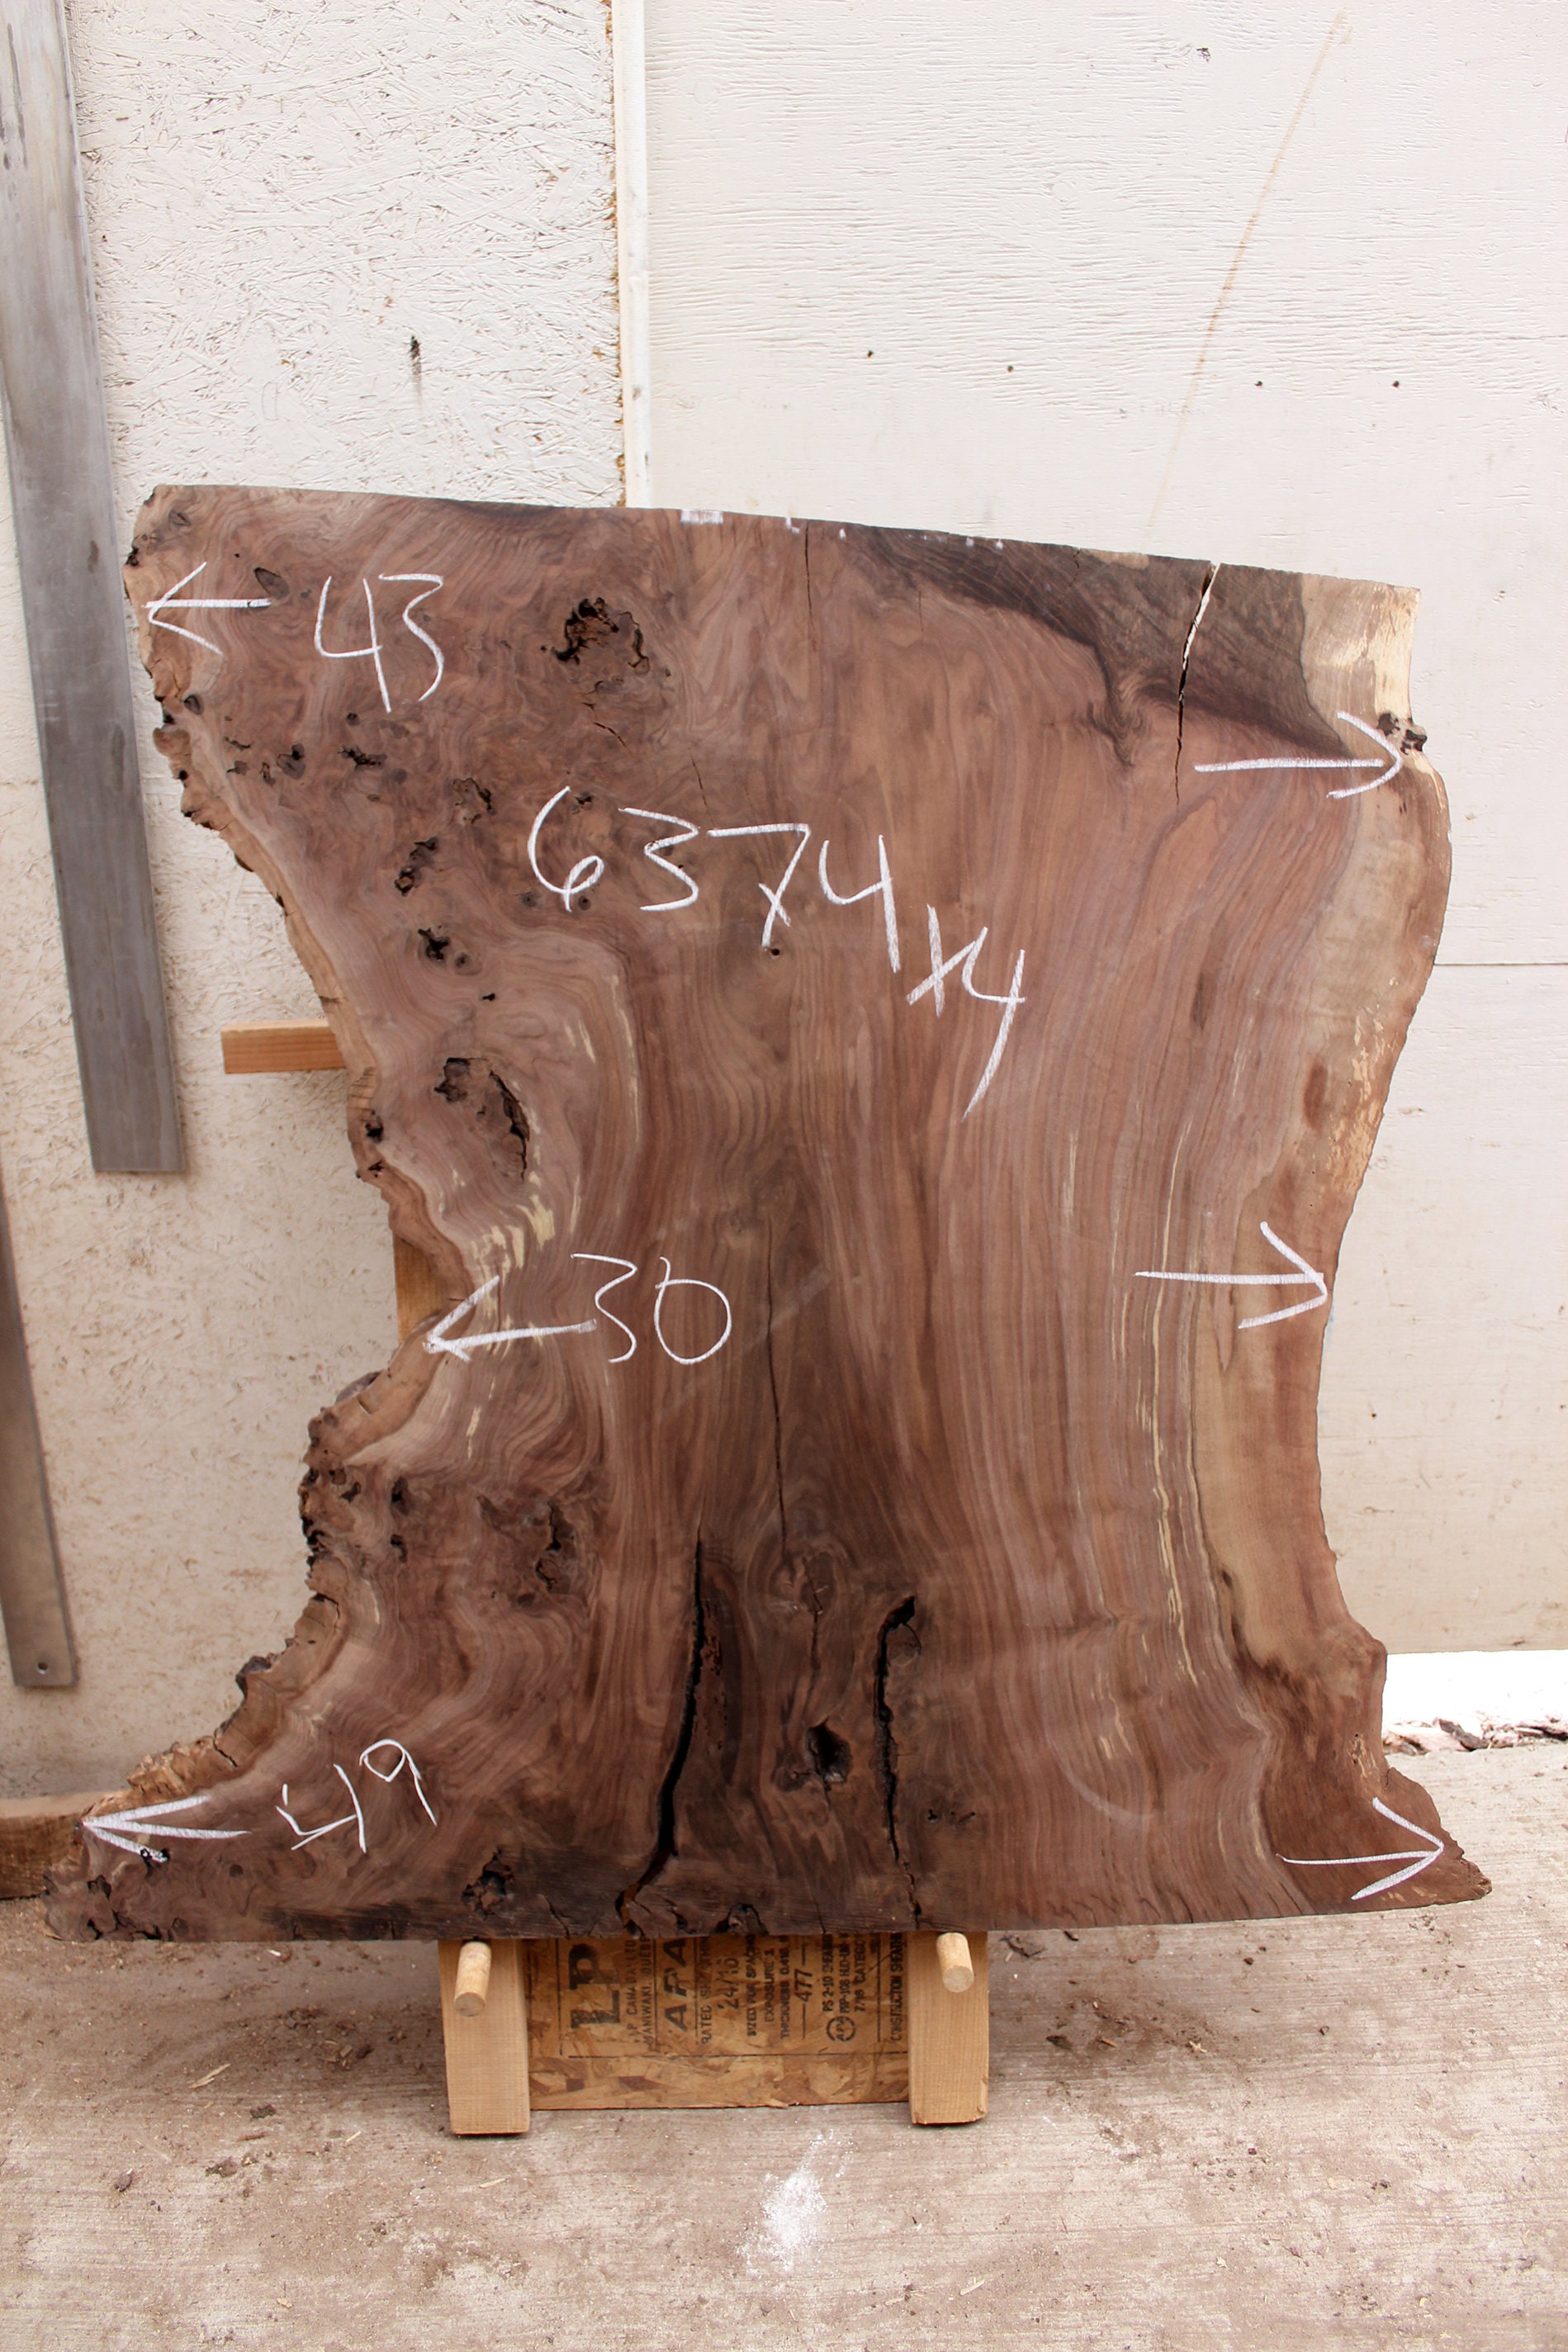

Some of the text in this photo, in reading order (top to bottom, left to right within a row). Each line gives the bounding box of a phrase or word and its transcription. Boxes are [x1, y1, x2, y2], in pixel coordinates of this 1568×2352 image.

[314, 573, 443, 713] 43
[570, 1254, 732, 1365] 30
[275, 1738, 438, 1854] 49
[568, 1942, 620, 2029] LP
[663, 1937, 687, 2032] APA
[746, 1983, 756, 2003] FOR
[764, 1961, 774, 2022] EXPOSURE
[779, 1980, 789, 2039] THICKNESS
[794, 1969, 812, 2003] 477
[822, 1976, 833, 1997] 2-10
[822, 2000, 834, 2012] PS
[889, 1975, 902, 2041] CONSTRUCTION
[700, 2006, 712, 2045] RATED
[746, 2008, 756, 2037] SIZED
